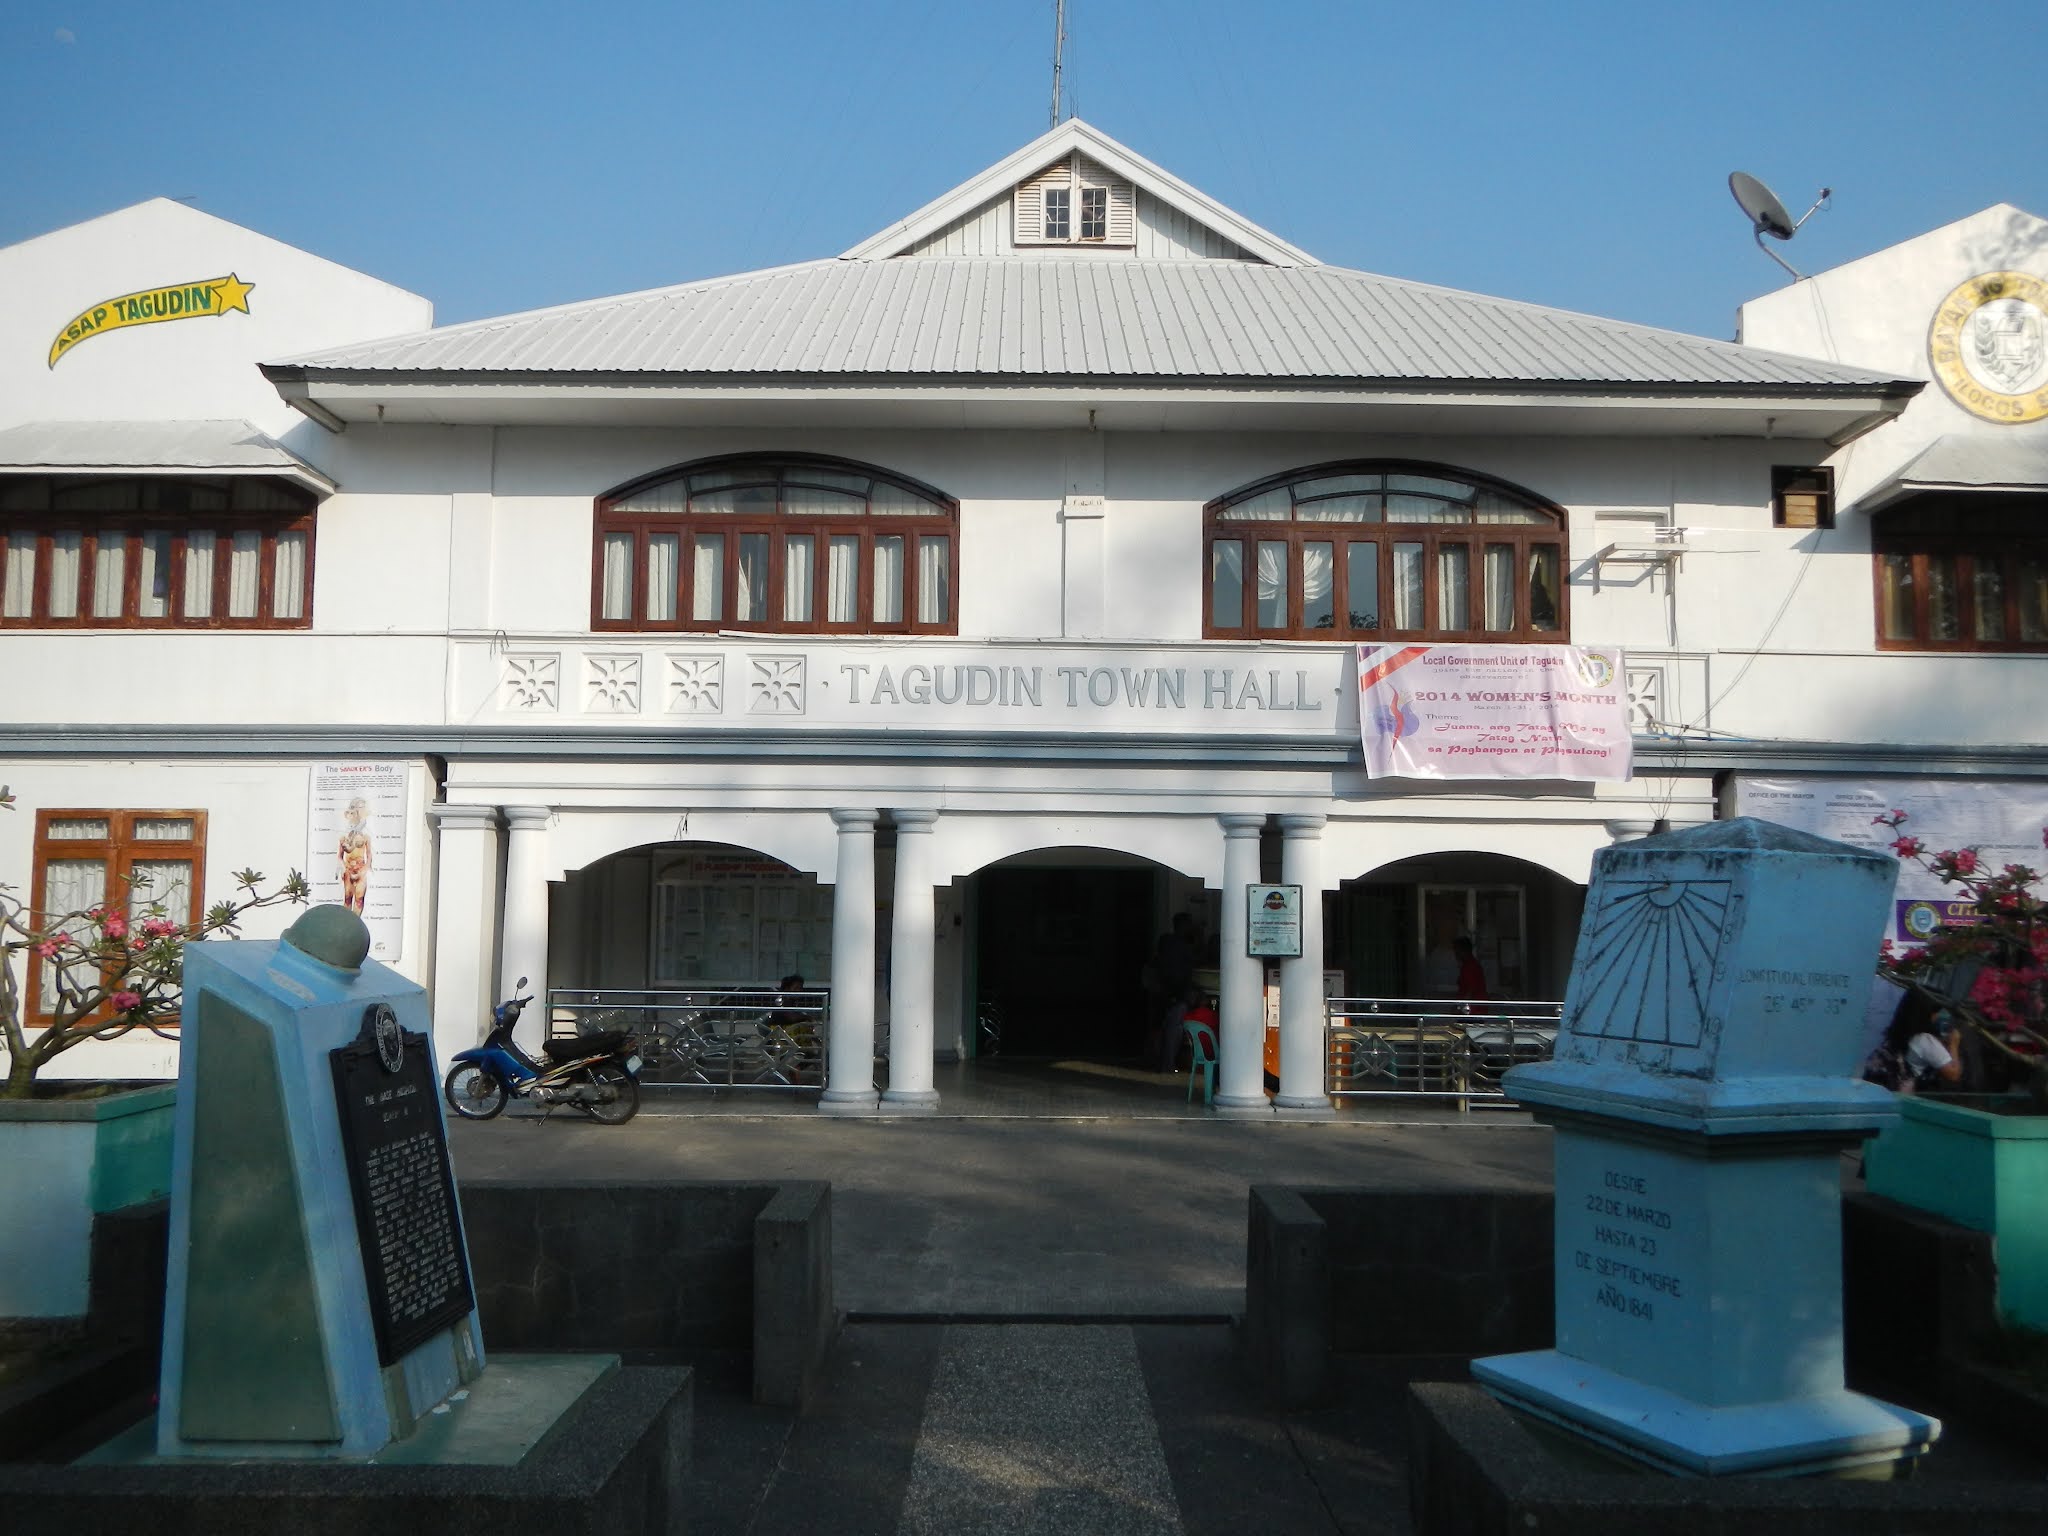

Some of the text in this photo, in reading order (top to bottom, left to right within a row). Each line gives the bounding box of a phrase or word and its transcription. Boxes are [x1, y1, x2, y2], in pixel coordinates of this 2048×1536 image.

[57, 285, 212, 352] ASAP TAGUDIN
[1955, 378, 2025, 417] ILOCOS
[1422, 655, 1564, 668] Local Government Unit of Tagudin
[840, 663, 1323, 711] TAGUDIN TOWN HALL
[1414, 690, 1617, 705] 2014 WOMEN'S MONTH
[1434, 722, 1484, 732] Juana,
[1489, 724, 1511, 732] ang
[1592, 726, 1606, 734] ay
[1427, 745, 1443, 753] sa
[1447, 745, 1519, 755] Pagbangon
[1523, 746, 1536, 754] at
[326, 764, 339, 773] The
[374, 764, 394, 774] Body
[1722, 923, 1734, 945] 8
[1605, 1170, 1647, 1195] DESDE
[1586, 1194, 1672, 1231] 22 DE MARZO
[1595, 1223, 1657, 1257] HASTA 23
[1575, 1250, 1682, 1298] DE SEPTIEMBRE
[1596, 1282, 1626, 1313] AÑO
